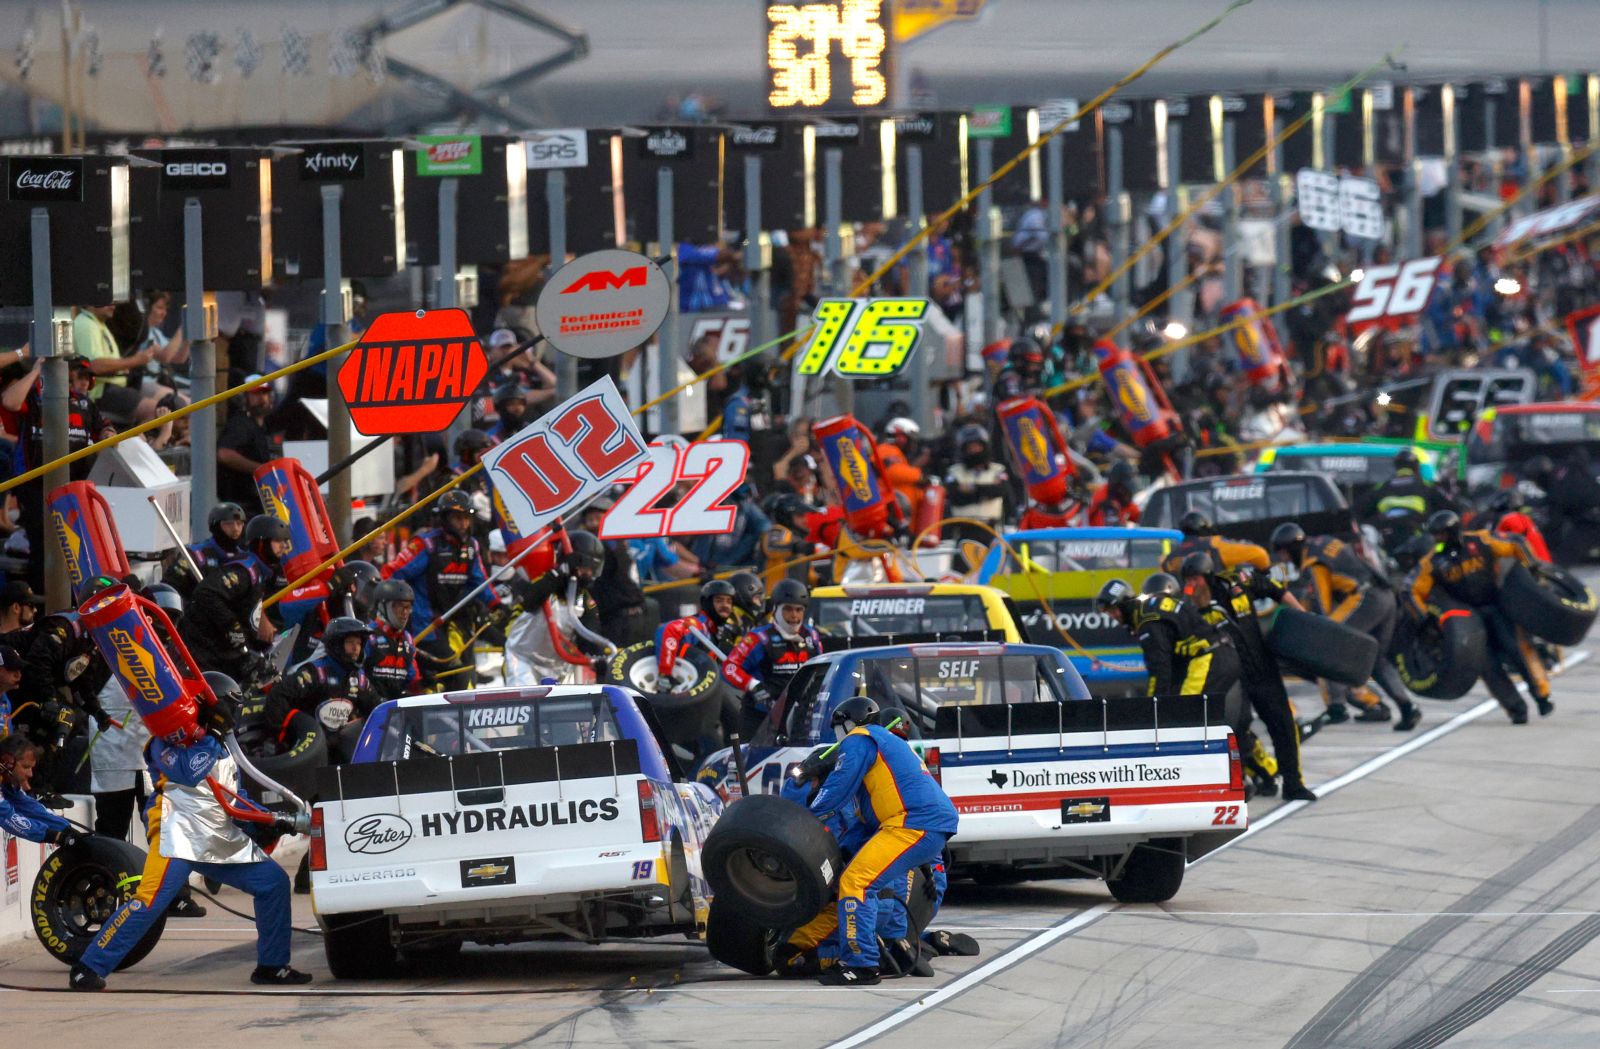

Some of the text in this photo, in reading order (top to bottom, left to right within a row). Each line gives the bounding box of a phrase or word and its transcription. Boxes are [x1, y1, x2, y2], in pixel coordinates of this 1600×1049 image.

[305, 153, 359, 172] xfinity
[532, 143, 578, 161] SRS
[16, 168, 74, 190] Coca-Cola
[166, 162, 227, 177] GEICO
[560, 266, 648, 295] AM
[1346, 256, 1444, 323] 56
[559, 319, 641, 333] Solutions
[560, 308, 643, 323] Technical
[798, 298, 930, 377] 16
[364, 342, 465, 403] NAPA
[492, 393, 646, 517] 02
[837, 436, 873, 503] SUNOCO
[599, 440, 750, 539] 22
[52, 511, 83, 586] SUNOCO
[851, 598, 926, 616] ENFINGER
[108, 628, 165, 705] SUNOCO
[938, 660, 980, 679] SELF
[468, 706, 532, 728] KRAUS
[1013, 765, 1180, 788] Don't mess with Texas
[421, 798, 620, 838] HYDRAULICS
[1212, 805, 1241, 826] 22
[345, 814, 413, 854] Gates
[598, 849, 632, 858] RST
[328, 867, 417, 884] SILVERADO
[631, 860, 654, 881] 19
[31, 857, 66, 953] GOODYEAR
[97, 907, 131, 950] AUTO PARTS
